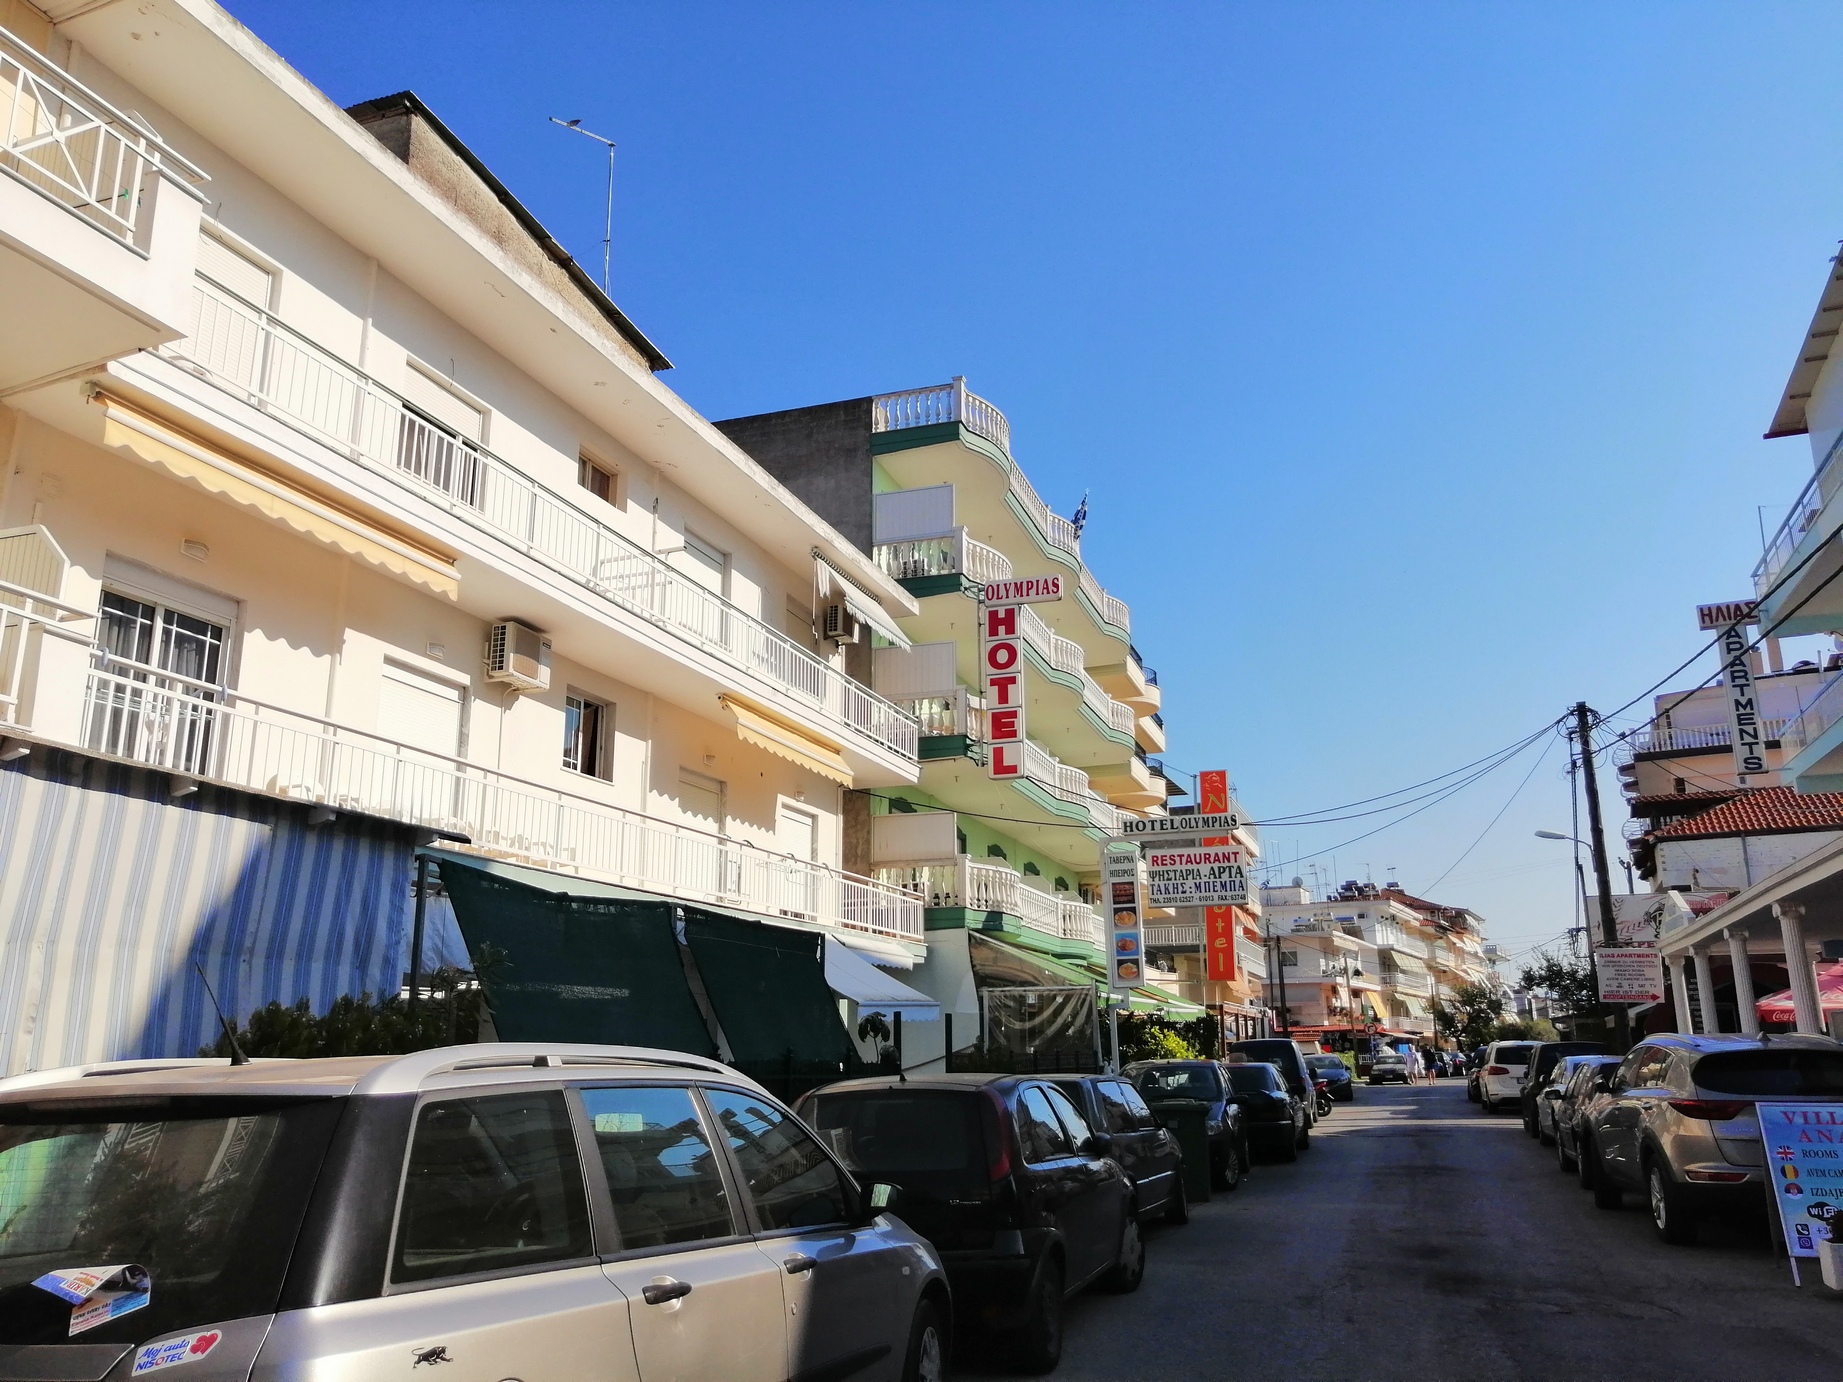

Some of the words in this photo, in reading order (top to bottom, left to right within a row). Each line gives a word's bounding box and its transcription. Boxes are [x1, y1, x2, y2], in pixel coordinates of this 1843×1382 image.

[986, 577, 1060, 601] OLYMPIAS
[988, 607, 1018, 776] HOTEL
[1725, 626, 1763, 771] APARTMENTS
[1122, 819, 1179, 834] HOTEL
[1180, 814, 1238, 831] OLYMPIAS
[1109, 855, 1135, 865] ΤΑΒΕΡΝΑ
[1151, 851, 1240, 867] RESTAURANT
[1109, 868, 1135, 878] ΗΠΕΙΡΟΣ
[1801, 1149, 1839, 1159] ROOMS
[1806, 1168, 1827, 1178] AVEM
[138, 1344, 164, 1359] Moj
[163, 1338, 190, 1352] auto
[135, 1351, 186, 1372] NISOTEC
